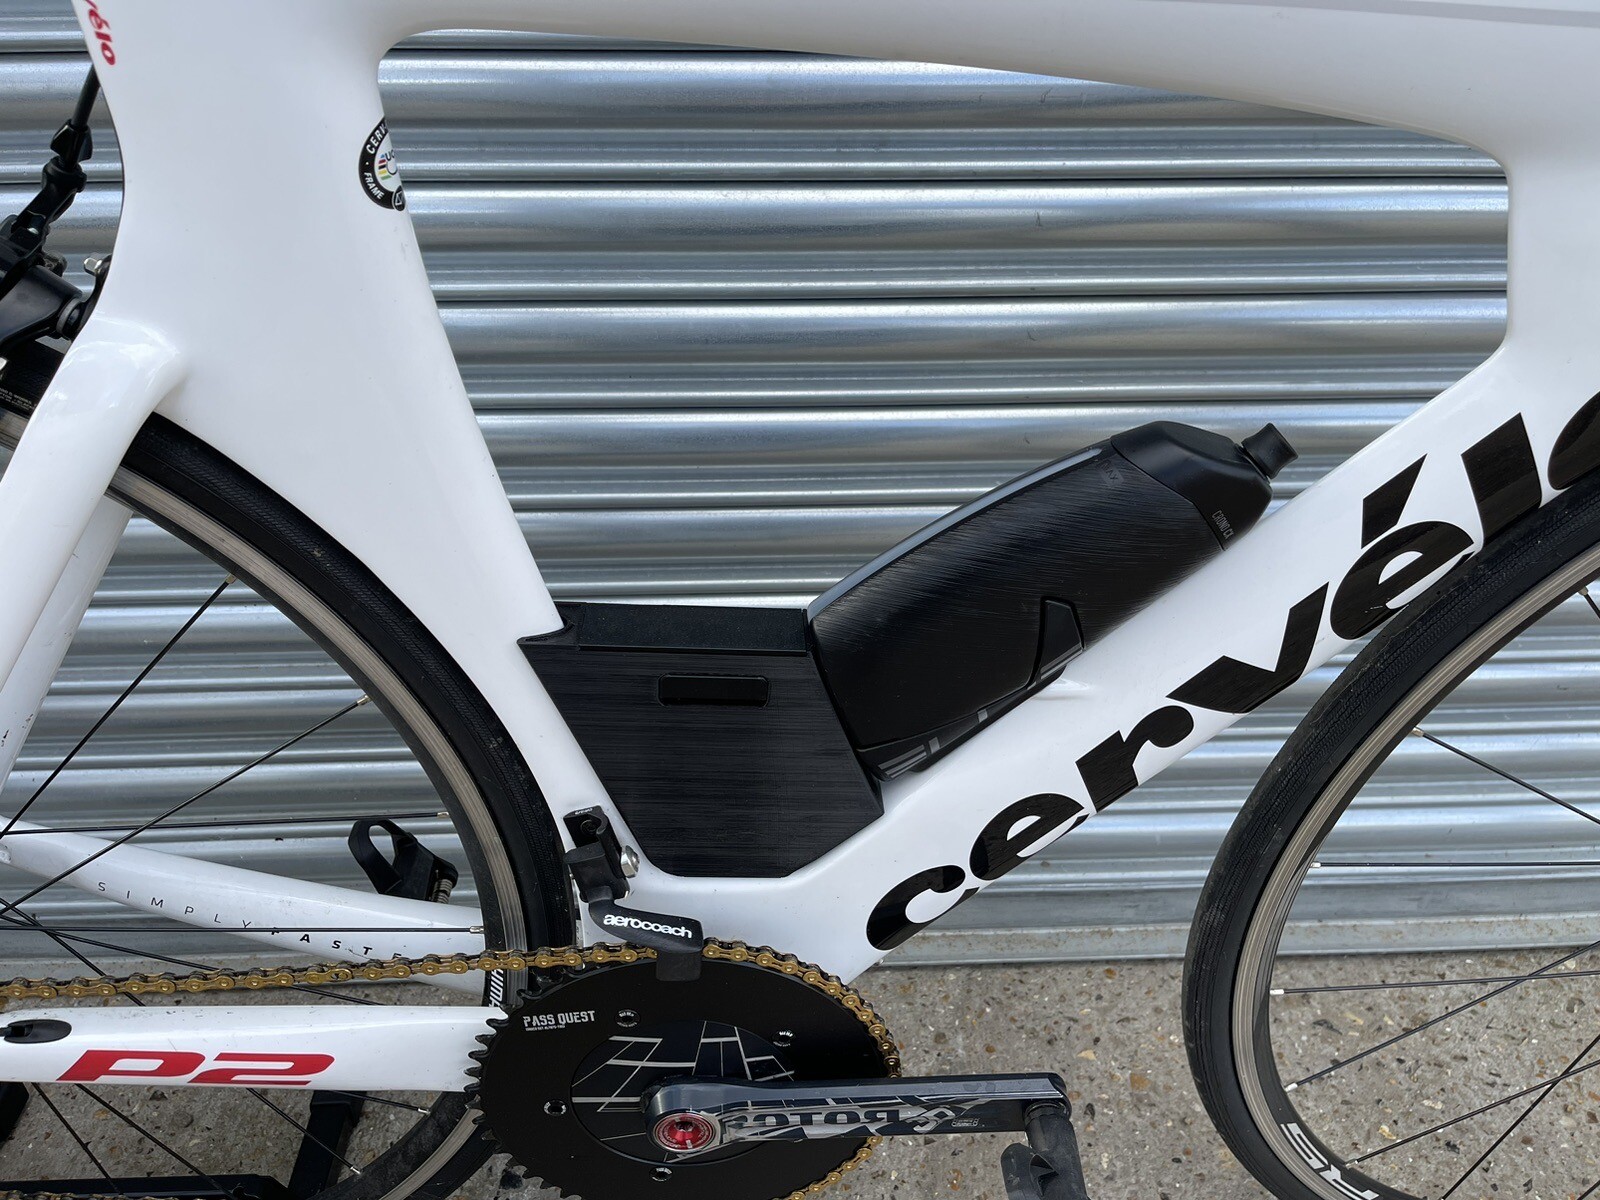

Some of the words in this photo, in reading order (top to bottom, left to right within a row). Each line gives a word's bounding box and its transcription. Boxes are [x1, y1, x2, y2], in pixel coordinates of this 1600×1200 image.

[364, 172, 385, 200] FRAME
[1212, 510, 1231, 533] CRONO
[98, 881, 252, 929] SIMPLY
[603, 914, 693, 939] aerocoach
[523, 1013, 556, 1027] PASS
[558, 1010, 596, 1026] QUEST
[56, 1049, 335, 1085] P2
